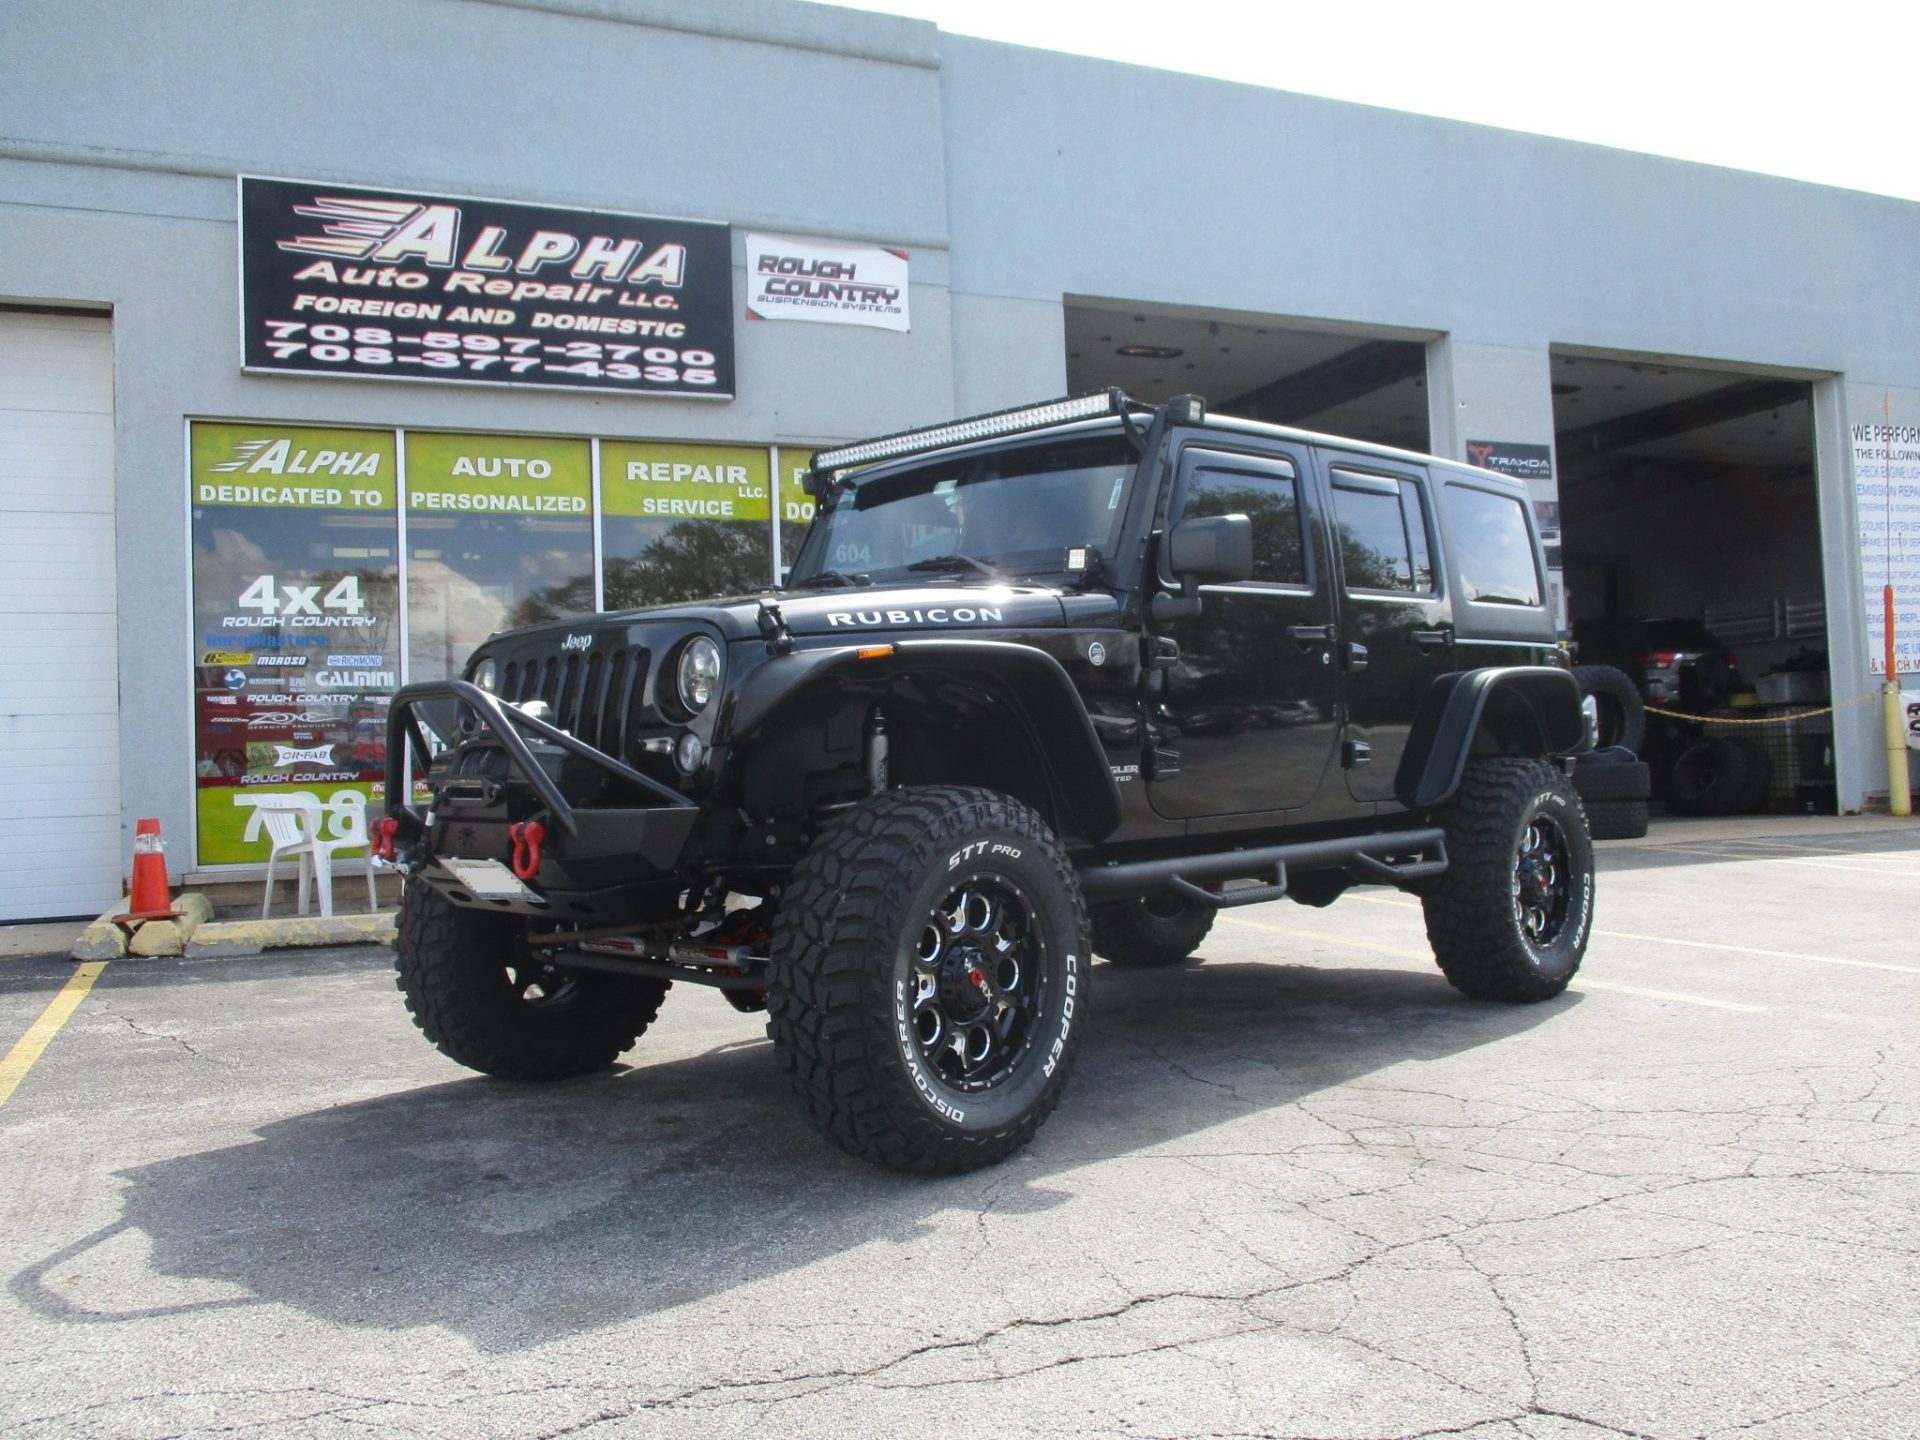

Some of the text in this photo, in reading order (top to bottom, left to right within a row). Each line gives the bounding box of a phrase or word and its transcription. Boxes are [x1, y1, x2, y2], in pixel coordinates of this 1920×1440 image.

[372, 205, 687, 287] ALPHA
[757, 254, 857, 280] ROUGH
[293, 261, 679, 310] Auto Repair LLC.
[764, 277, 900, 305] COUNTRY
[757, 295, 902, 314] SUSPENSION SYSTEMS
[293, 294, 686, 338] FOREIGN AND DOMESTIC
[264, 320, 716, 366] 708-597-2700
[1852, 424, 1871, 442] WE
[246, 440, 381, 477] ALPHA
[1488, 456, 1549, 469] TRAXDA
[1855, 448, 1873, 460] THE
[451, 456, 552, 479] AUTO
[627, 461, 748, 485] REPAIR
[200, 485, 383, 507] DEDICATED TO
[411, 491, 587, 512] PERSONALIZED
[738, 487, 768, 498] LLC.
[643, 498, 734, 516] SERVICE
[238, 575, 364, 615] 4x4
[222, 616, 376, 628] ROUGH COUNTRY
[826, 608, 1003, 627] RUBICON
[561, 633, 592, 651] Jeep
[256, 656, 307, 666] MOROSO
[341, 656, 381, 665] RICHMOND
[315, 671, 395, 687] CALMINI
[246, 694, 293, 703] ROUGH
[296, 694, 358, 702] COUNTRY
[282, 750, 327, 760] OR-FAB
[240, 772, 359, 784] ROUGH COUNTRY
[948, 841, 1022, 871] STT PRO
[1573, 872, 1590, 950] COOPER
[1042, 954, 1076, 1078] COOPER
[897, 980, 964, 1123] DISCOVERER
